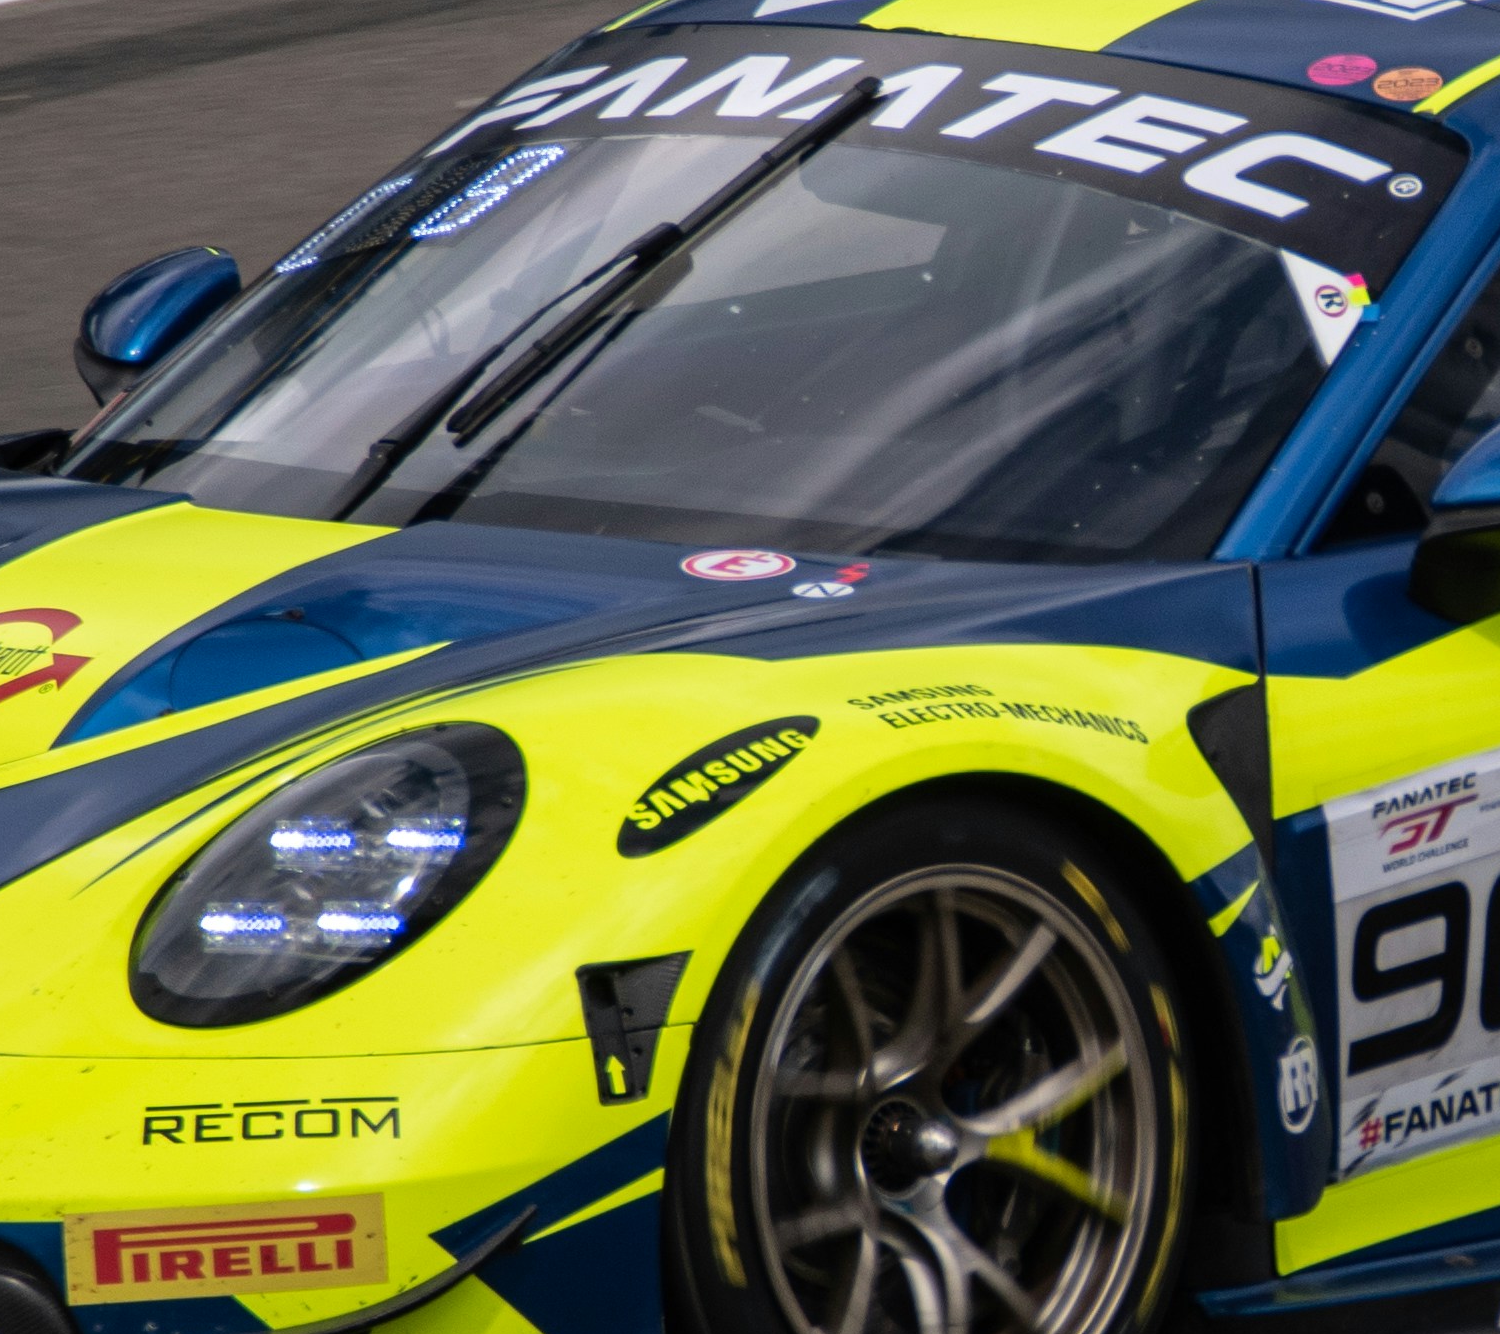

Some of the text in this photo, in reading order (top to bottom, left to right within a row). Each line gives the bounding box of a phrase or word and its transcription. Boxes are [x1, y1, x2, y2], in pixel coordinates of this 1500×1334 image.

[422, 53, 1395, 219] FANATEC
[847, 683, 996, 710] SAMSUNG
[878, 701, 1149, 745] ELECTRO-MECHANICS
[626, 727, 811, 830] SAMSUNG
[1372, 772, 1477, 818] FANATEC
[143, 1103, 403, 1146] RECOM
[93, 1213, 357, 1286] PIRELLI
